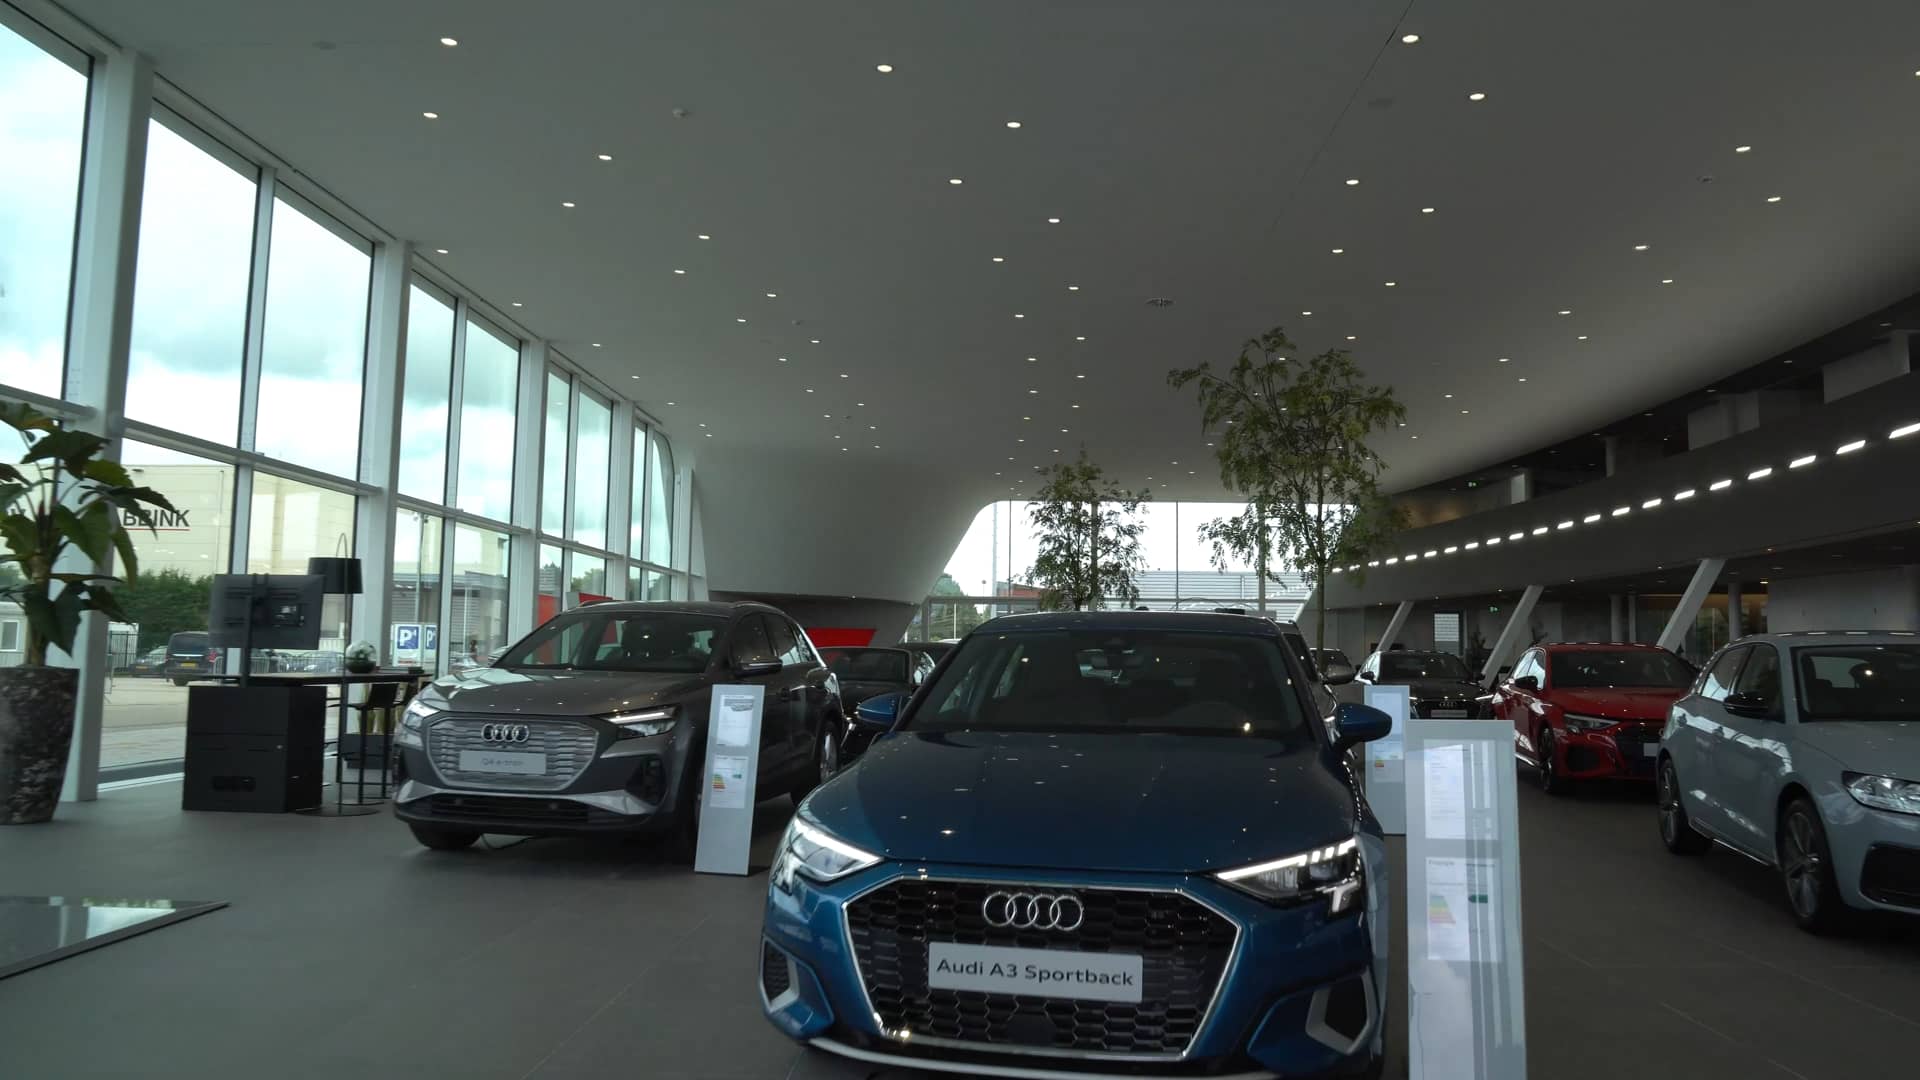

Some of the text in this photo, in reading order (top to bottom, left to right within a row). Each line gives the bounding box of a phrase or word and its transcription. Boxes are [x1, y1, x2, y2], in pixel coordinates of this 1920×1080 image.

[399, 629, 412, 646] P
[936, 958, 1134, 986] Audi A3 Sportback
